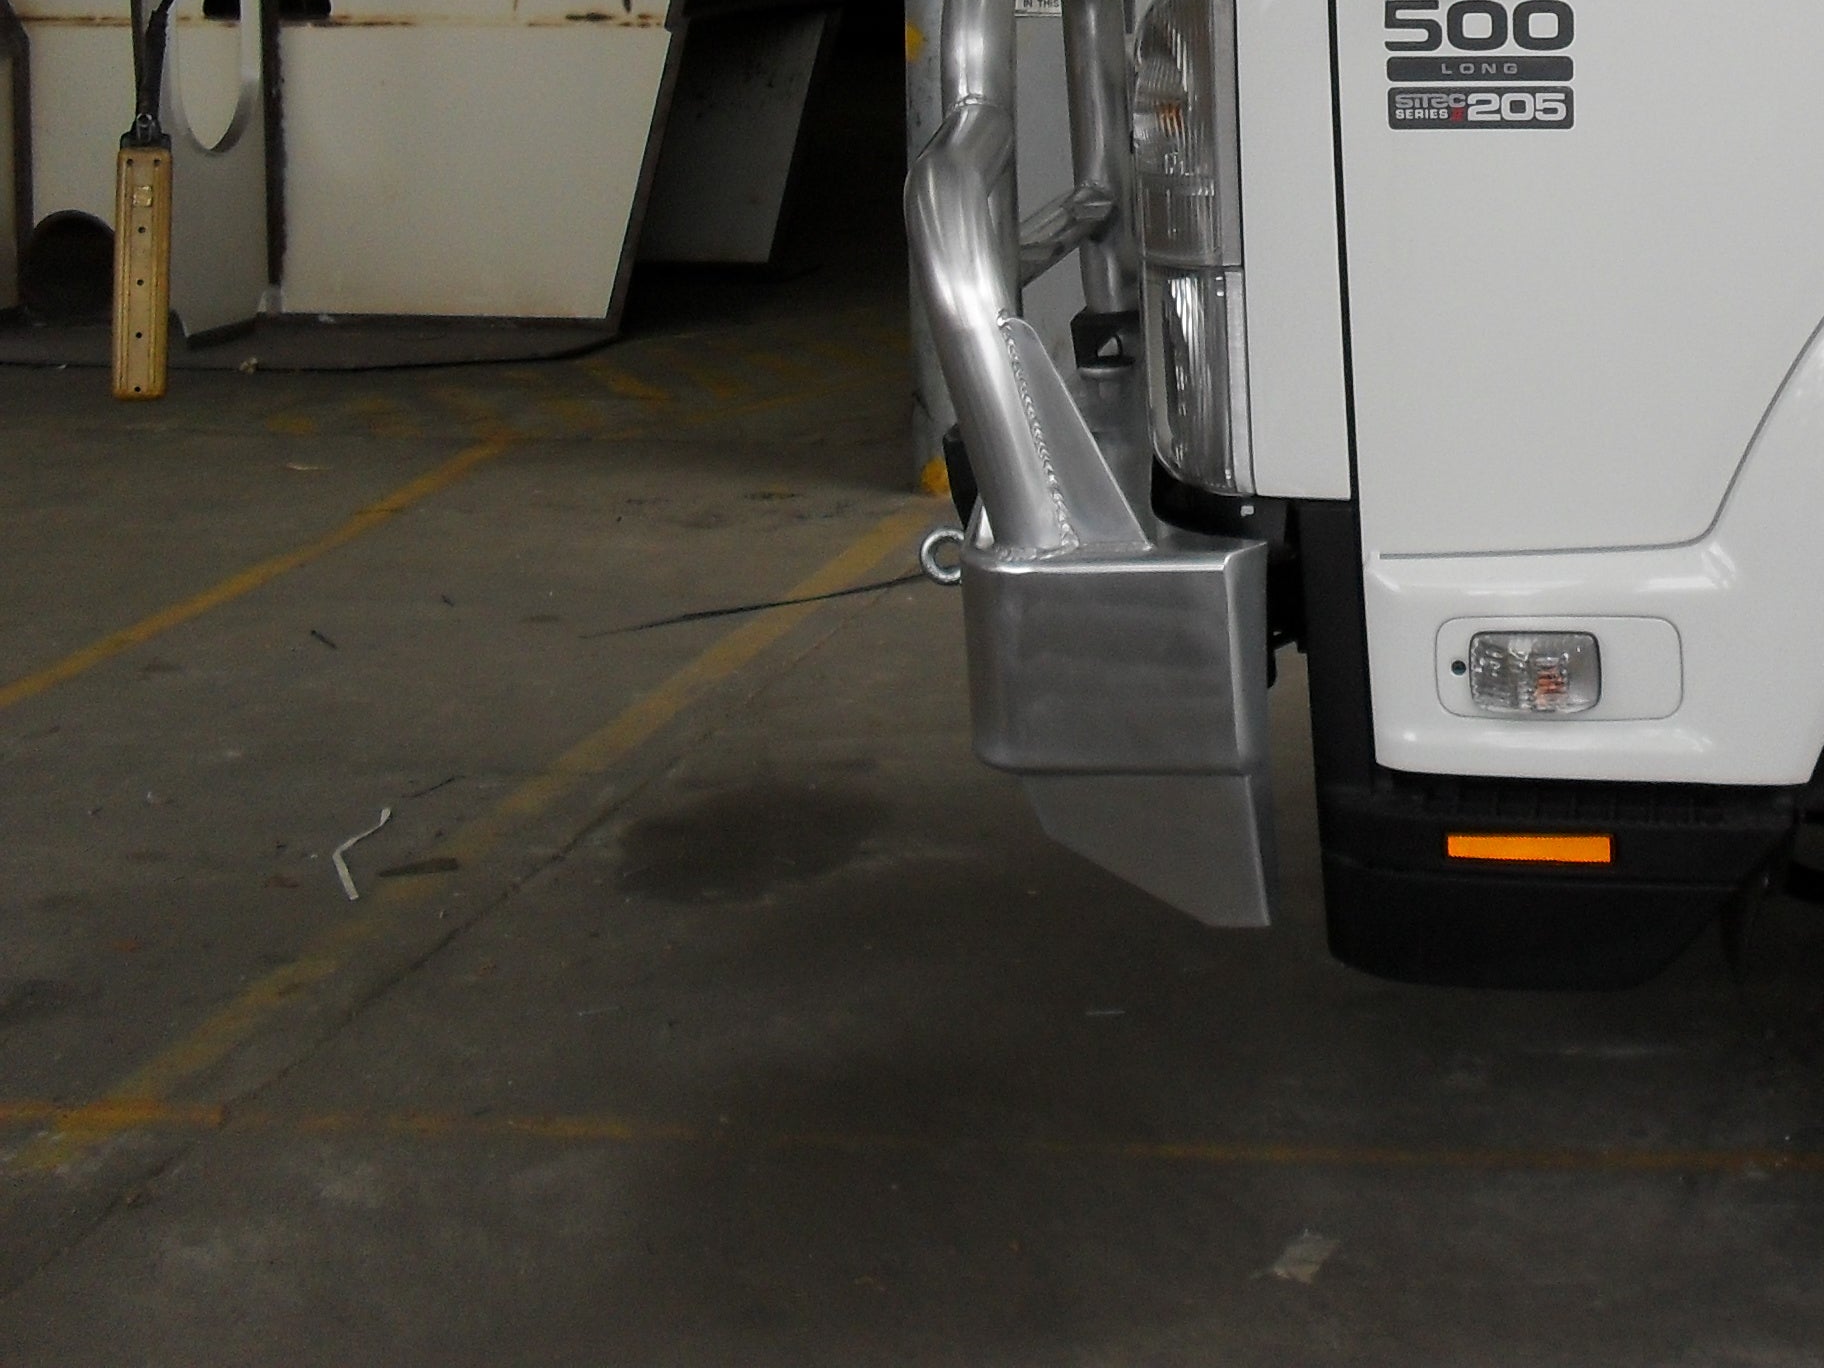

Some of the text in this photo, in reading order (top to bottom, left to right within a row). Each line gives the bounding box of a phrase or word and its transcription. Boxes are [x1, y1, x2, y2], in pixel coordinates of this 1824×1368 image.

[1023, 0, 1060, 8] IN THIS
[1384, 0, 1575, 51] 500
[1441, 63, 1518, 74] LONG
[1467, 92, 1566, 121] 205
[1395, 109, 1448, 119] SERIES
